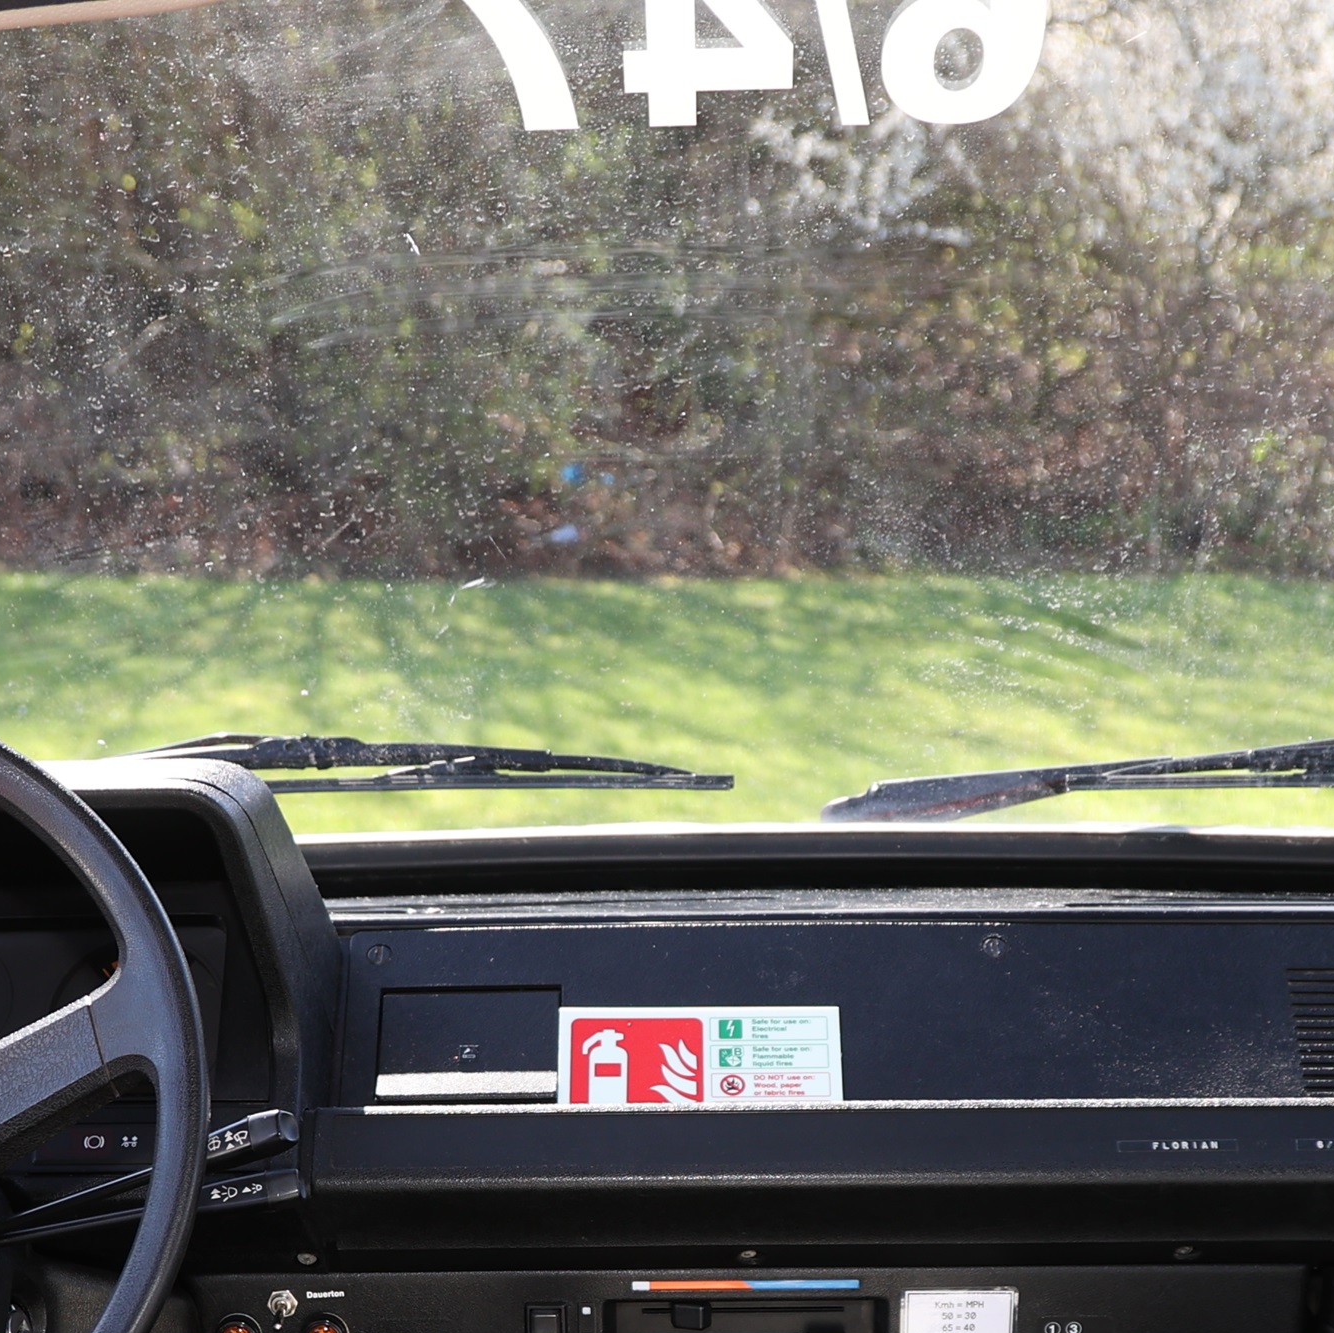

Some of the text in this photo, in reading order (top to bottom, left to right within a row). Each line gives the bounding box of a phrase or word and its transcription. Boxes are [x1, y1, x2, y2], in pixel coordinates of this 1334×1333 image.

[734, 1048, 742, 1056] B
[1152, 1141, 1218, 1150] FLORIAN
[307, 1291, 345, 1299] Dauerton
[942, 1312, 954, 1320] 50
[965, 1312, 977, 1320] 30
[942, 1324, 953, 1332] 65
[1069, 1324, 1078, 1333] 3
